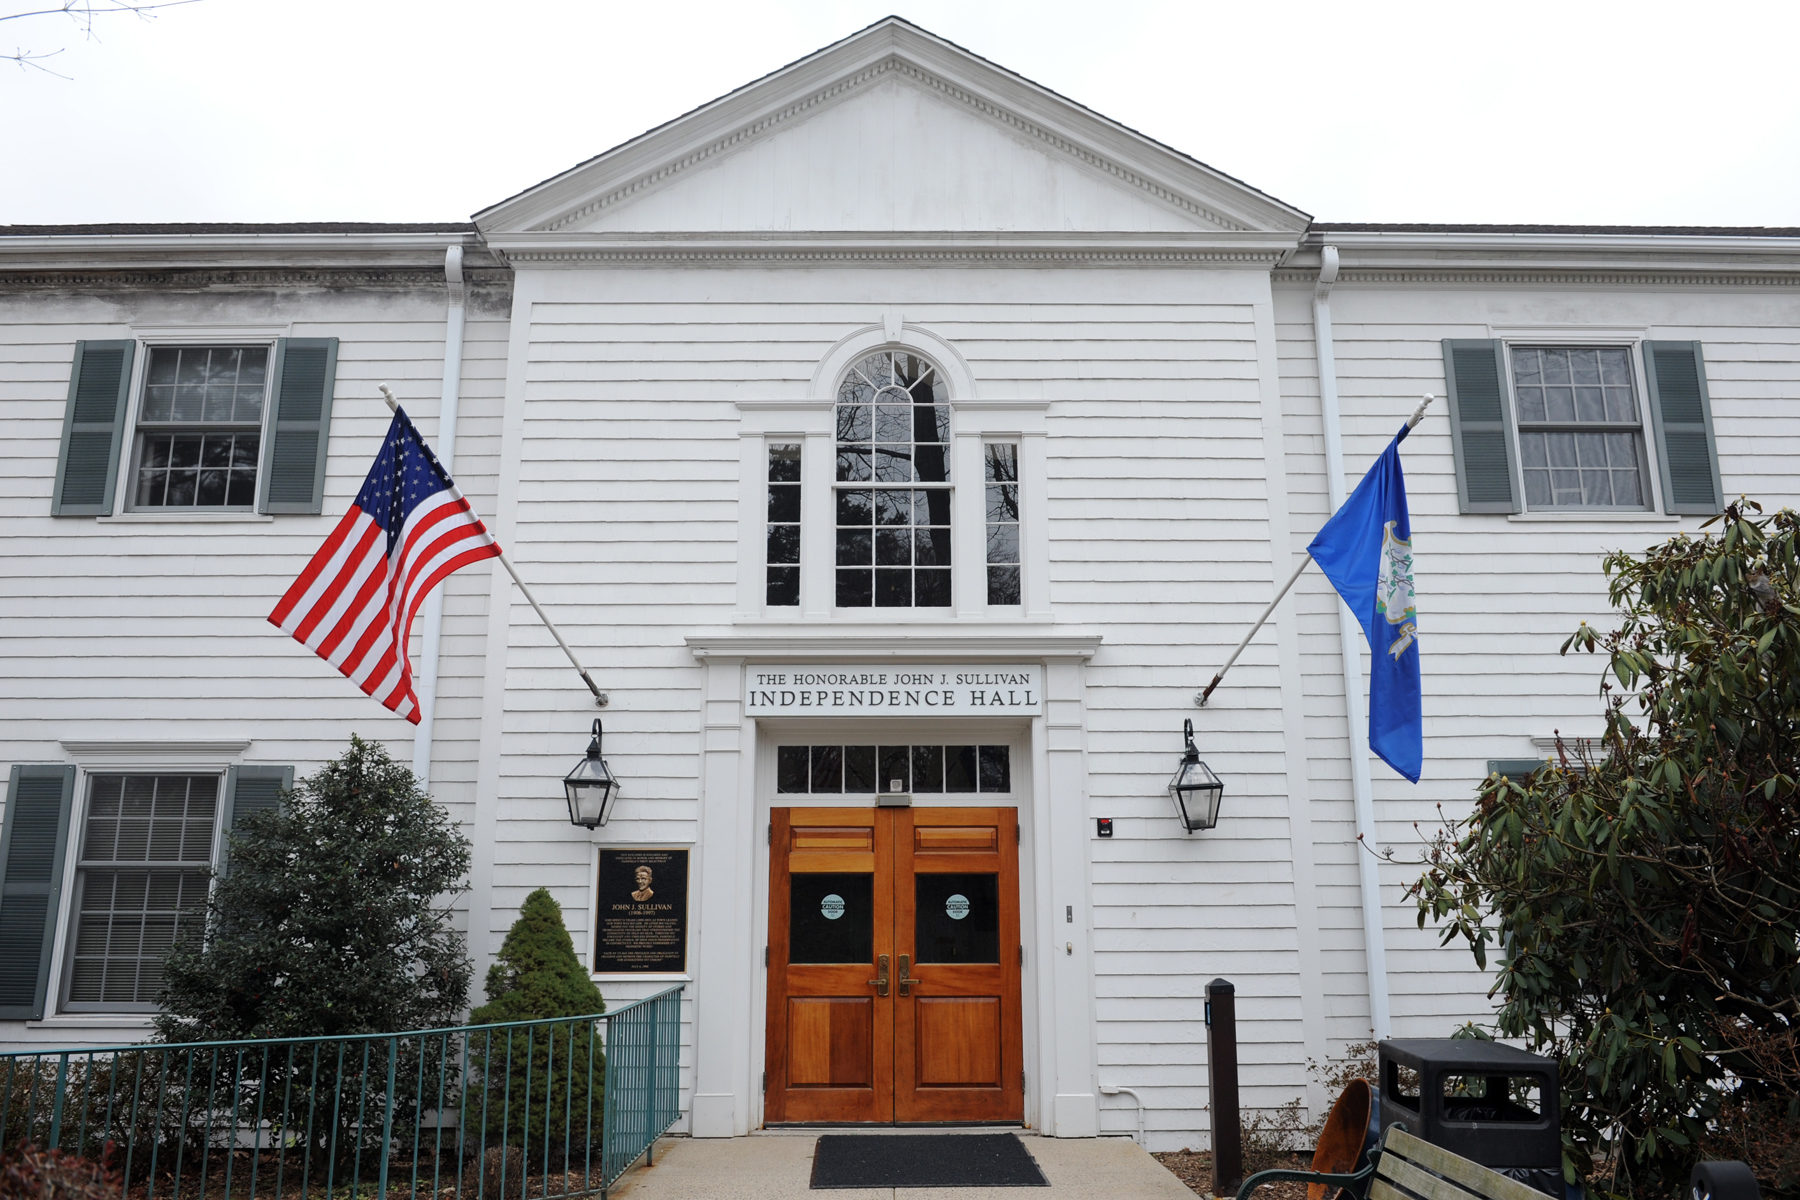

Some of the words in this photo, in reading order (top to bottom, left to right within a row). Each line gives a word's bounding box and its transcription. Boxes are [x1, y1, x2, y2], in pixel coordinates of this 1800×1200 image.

[757, 674, 786, 685] THE
[793, 674, 887, 685] HONORABLE
[894, 674, 933, 685] JOHN
[940, 674, 949, 685] J.
[956, 674, 1030, 685] SULLIVAN
[749, 690, 955, 706] INDEPENDENCE
[970, 690, 1038, 706] HALL
